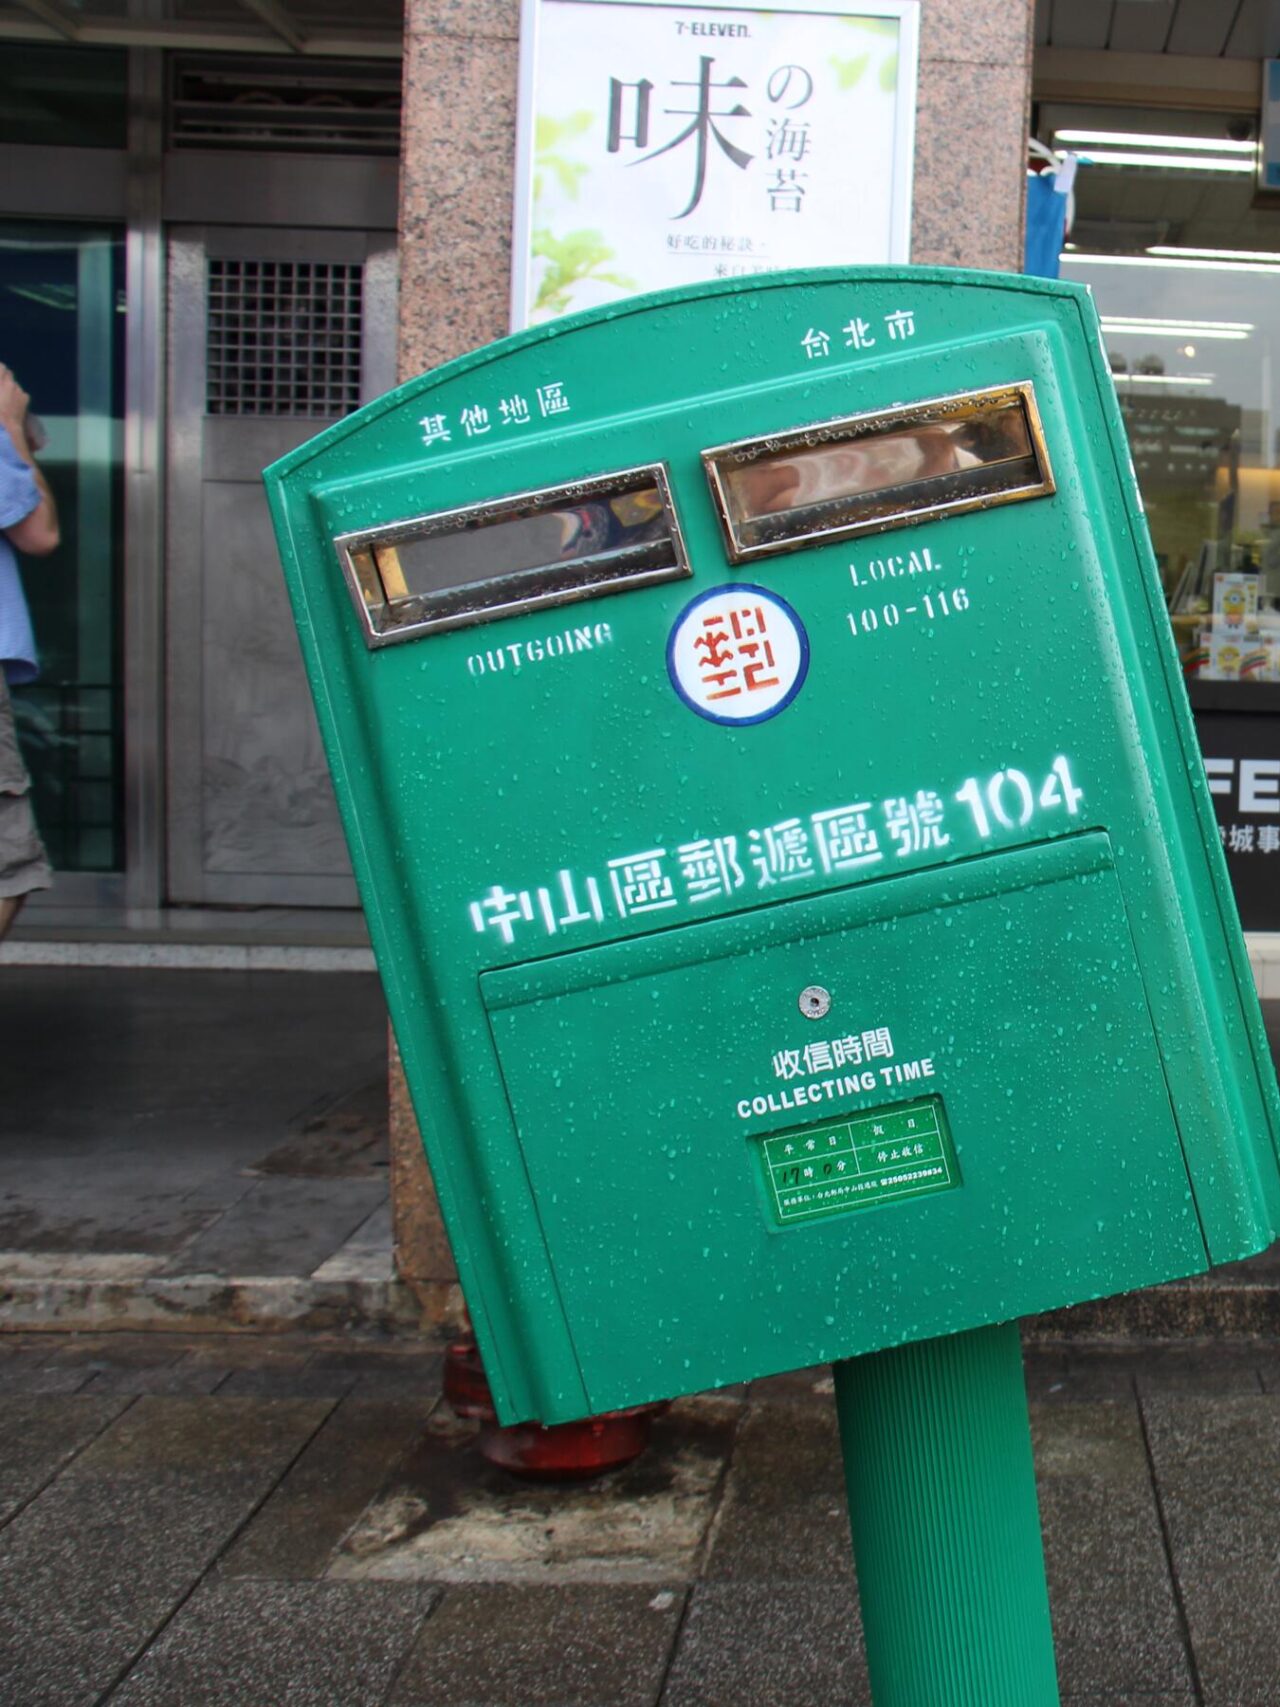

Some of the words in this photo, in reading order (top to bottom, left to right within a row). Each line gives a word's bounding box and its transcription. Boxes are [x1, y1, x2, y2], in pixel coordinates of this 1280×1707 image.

[606, 55, 755, 220] 味
[801, 310, 915, 358] 台北市
[419, 382, 570, 446] 其他地區
[849, 548, 942, 587] LOCAL
[846, 588, 970, 636] 100-116
[467, 622, 613, 676] OUTGOING
[772, 1027, 894, 1080] 收信時間
[737, 1072, 876, 1118] COLLECTING
[880, 1058, 936, 1086] TIME
